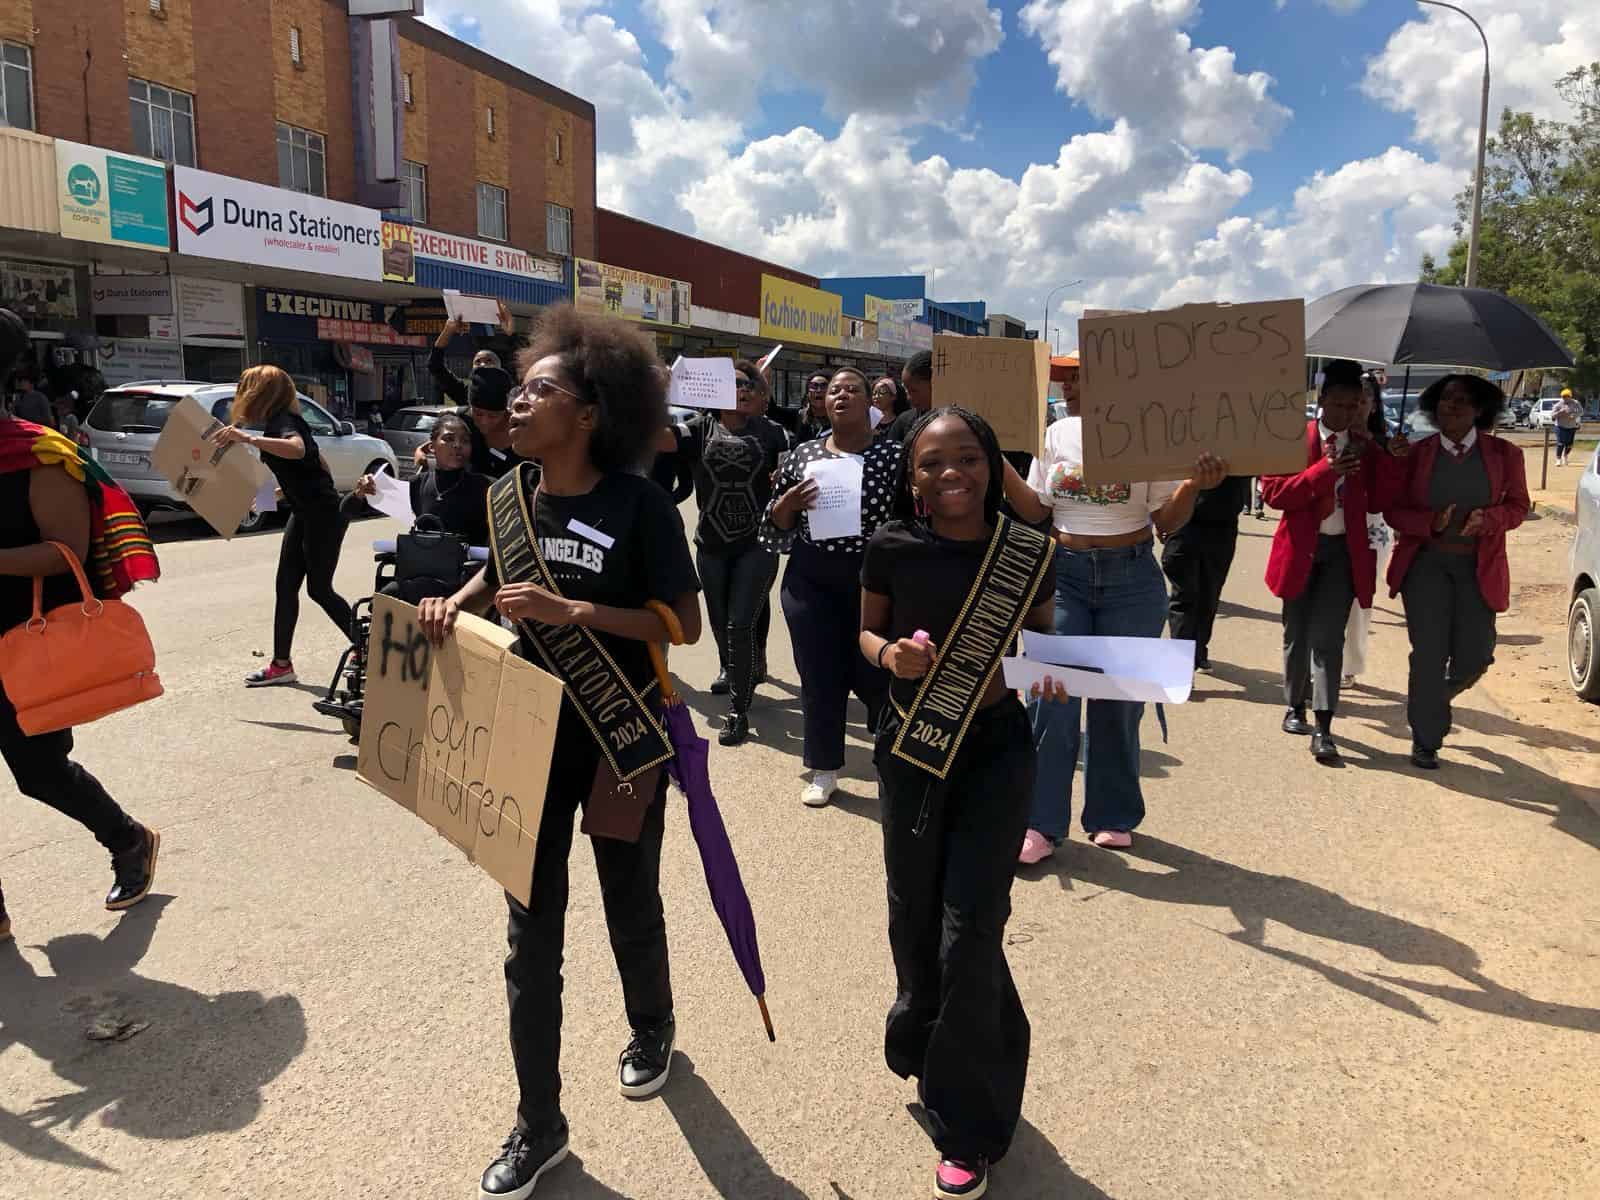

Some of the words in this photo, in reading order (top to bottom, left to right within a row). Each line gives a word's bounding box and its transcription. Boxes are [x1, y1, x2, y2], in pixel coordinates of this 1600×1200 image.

[223, 198, 282, 233] Duna
[288, 210, 380, 247] Stationers
[413, 231, 488, 265] EXECUTIVE
[265, 292, 372, 321] EXECUTIVE
[765, 292, 807, 332] fashion
[810, 310, 838, 337] world
[1139, 390, 1200, 449] not
[989, 544, 1037, 596] ELITE
[923, 662, 979, 722] JUNIOR
[609, 723, 649, 751] 2024
[910, 719, 952, 752] 2024
